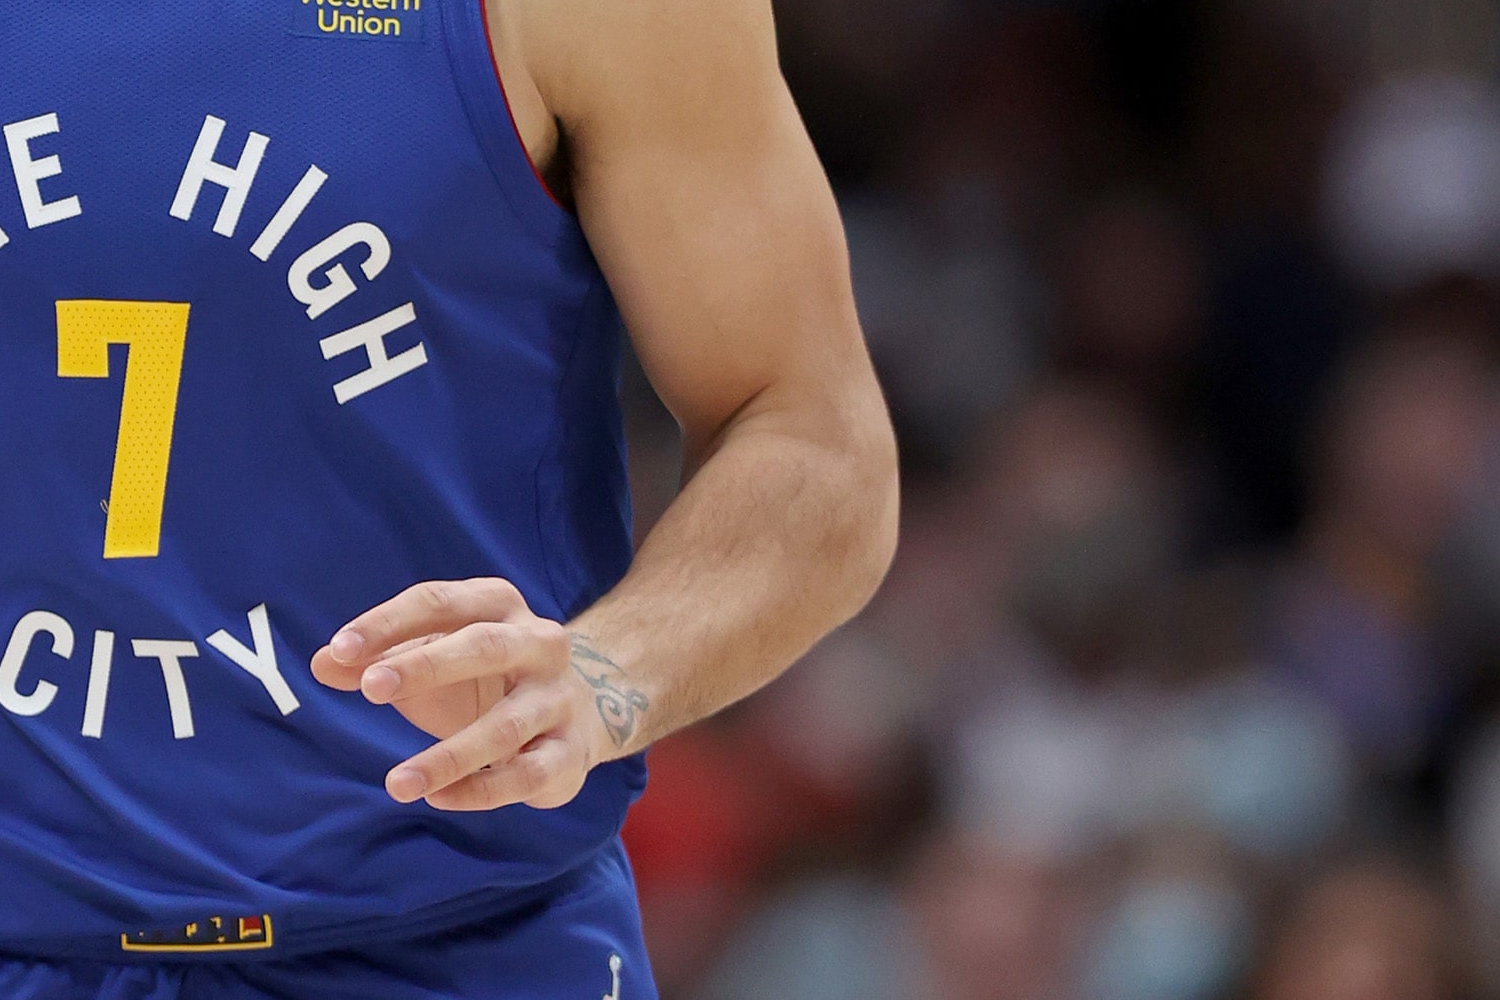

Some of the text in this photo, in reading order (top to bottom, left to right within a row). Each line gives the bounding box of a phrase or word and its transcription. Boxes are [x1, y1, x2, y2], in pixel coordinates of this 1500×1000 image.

[318, 8, 400, 36] Union
[170, 116, 426, 403] HIGH
[56, 300, 190, 558] 7
